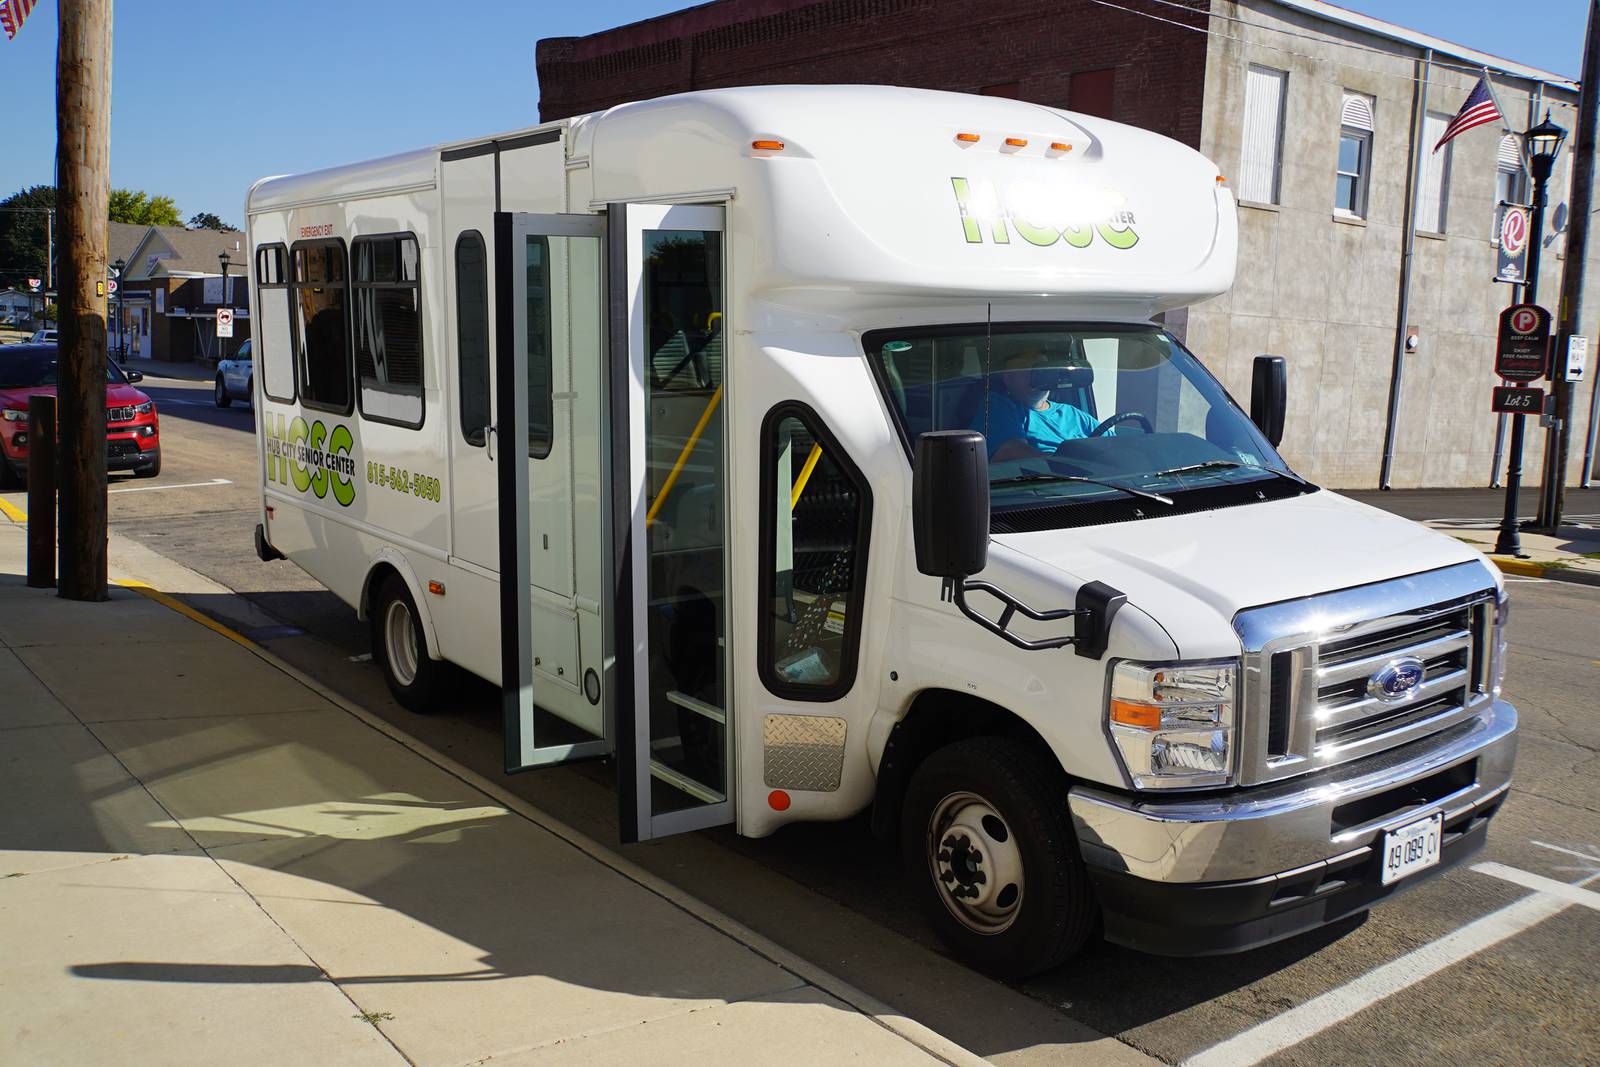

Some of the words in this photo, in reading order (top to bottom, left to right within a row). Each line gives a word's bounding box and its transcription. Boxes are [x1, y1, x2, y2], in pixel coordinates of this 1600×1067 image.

[300, 225, 324, 237] EMERGENCY
[324, 223, 333, 235] EXIT
[1505, 210, 1526, 250] R
[1519, 313, 1533, 329] P
[1504, 394, 1522, 406] Lot
[1522, 395, 1532, 407] 5
[265, 411, 356, 507] HCSC
[267, 438, 281, 454] HUB
[281, 442, 297, 458] CITY
[297, 446, 325, 468] SENIOR
[325, 452, 356, 477] CENTER
[367, 461, 441, 503] 815-562-5050
[1392, 670, 1417, 692] Ford
[1388, 845, 1402, 870] 49
